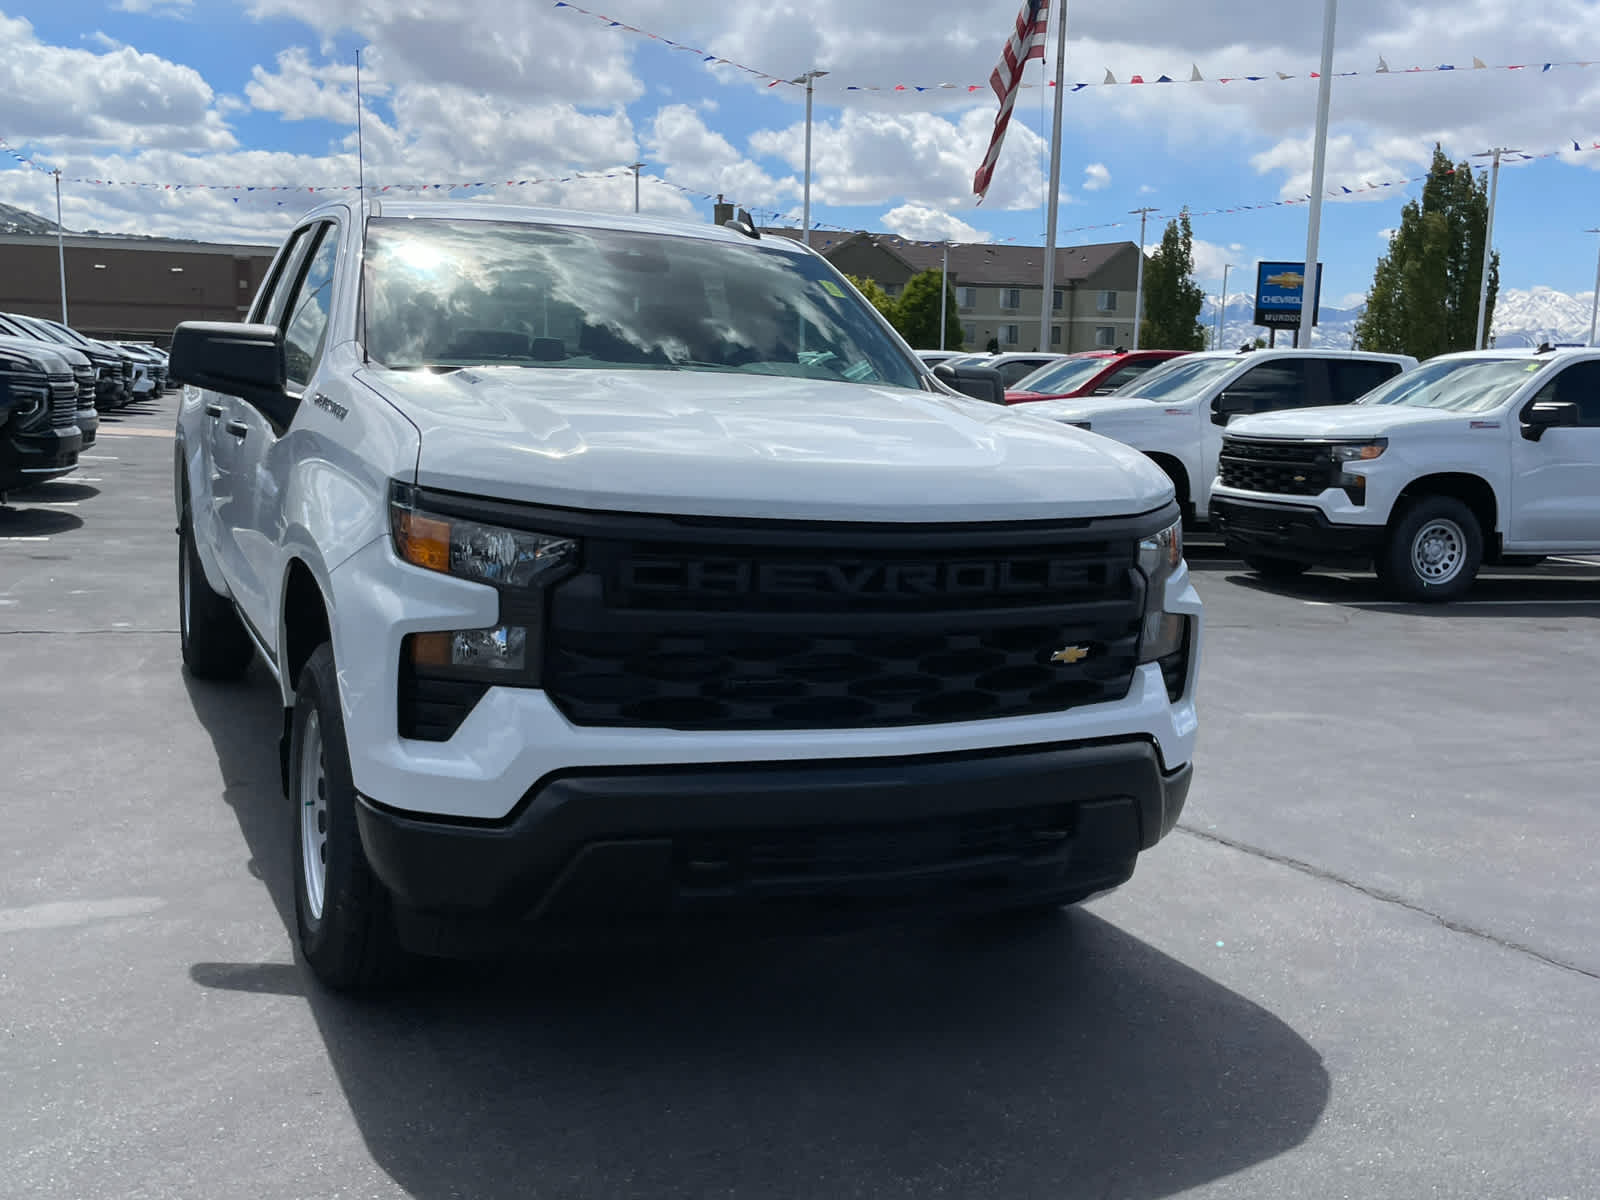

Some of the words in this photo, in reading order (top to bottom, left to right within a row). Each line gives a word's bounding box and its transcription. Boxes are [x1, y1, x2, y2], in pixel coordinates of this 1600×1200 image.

[1262, 295, 1304, 304] CHEVROL
[1264, 313, 1302, 322] MURDOC
[618, 555, 1130, 595] CHEVROLET
